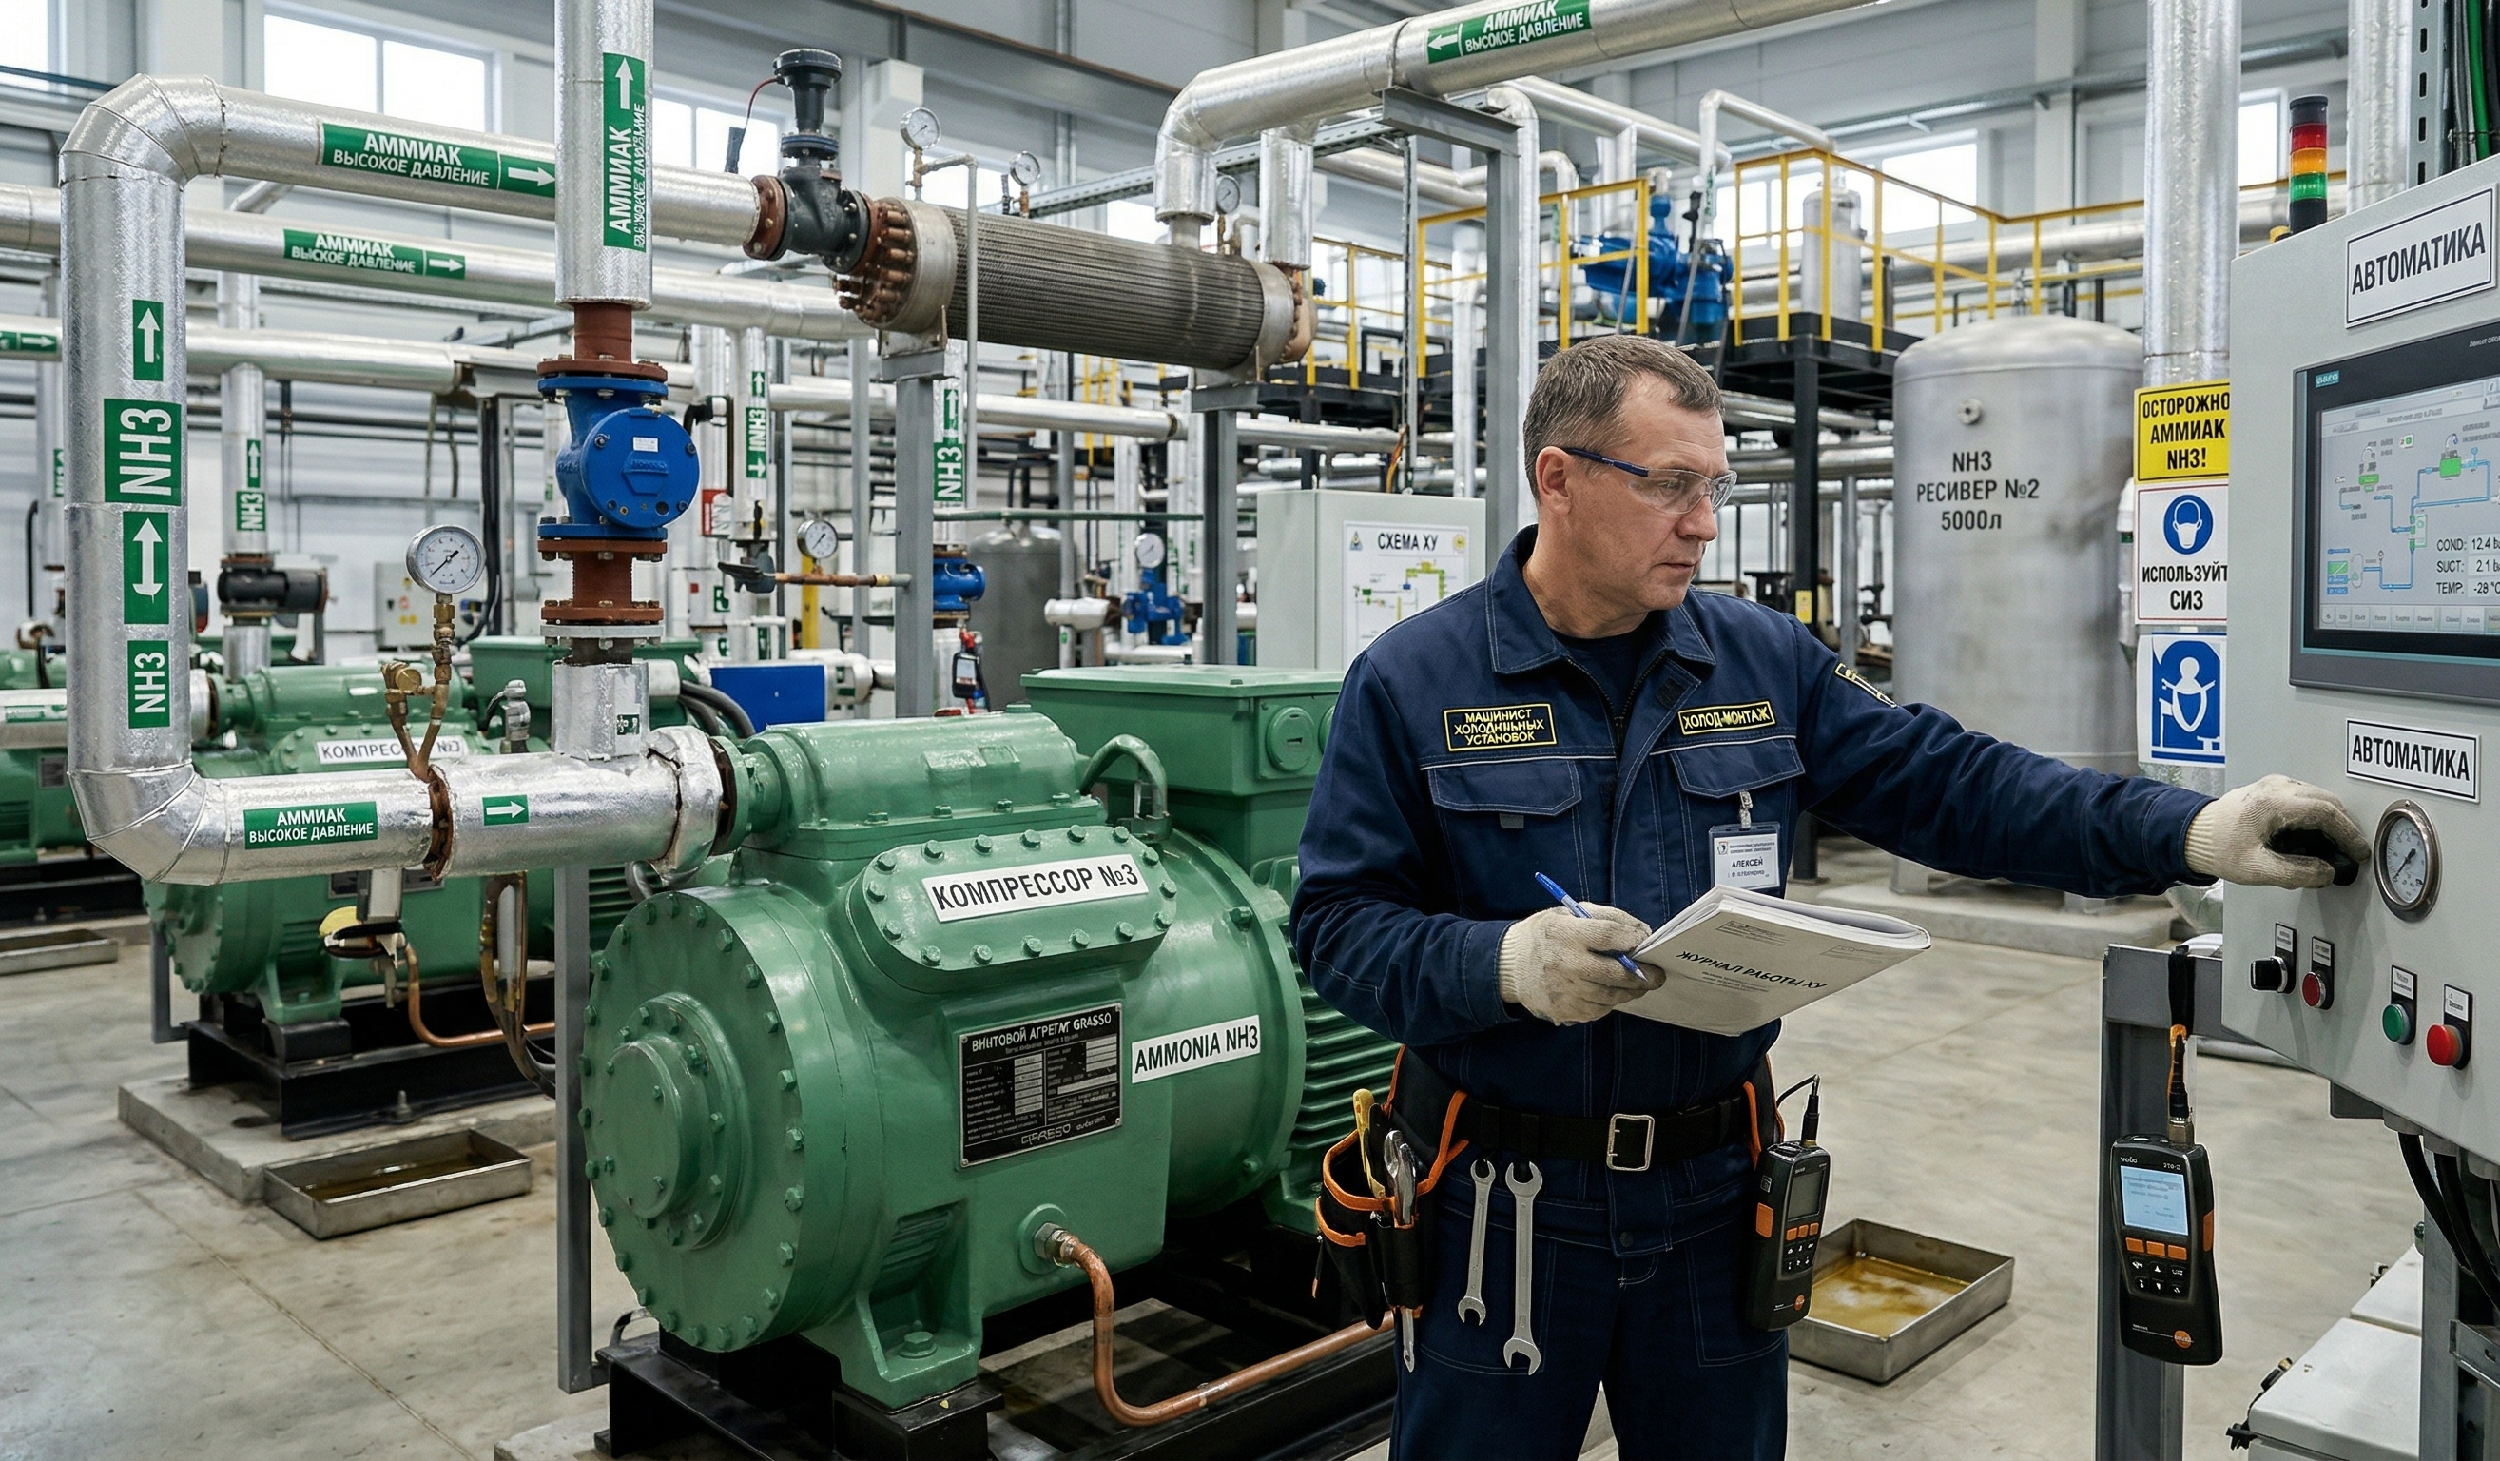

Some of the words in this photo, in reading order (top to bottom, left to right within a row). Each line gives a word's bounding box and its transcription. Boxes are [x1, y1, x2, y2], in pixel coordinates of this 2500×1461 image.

[1483, 0, 1559, 33] АММИАК
[1518, 12, 1584, 45] ДАВЛЕНИЕ
[363, 132, 463, 167] АММИАК
[333, 149, 408, 173] ВЫСОКОЕ
[410, 161, 490, 186] ДАВЛЕНИЕ
[609, 125, 632, 234] АММИАК
[315, 233, 396, 258] АММИАК
[2352, 222, 2486, 295] АВТОМАТИКА
[347, 253, 417, 274] ДАВЛЕНИЕ
[2142, 391, 2230, 419] ОСТОРОЖНО
[2150, 418, 2226, 445] АММИАК
[120, 408, 172, 496] NH3
[1952, 450, 1993, 473] NH3
[2167, 447, 2207, 470] NH3!
[936, 446, 963, 499] NH3
[1917, 479, 1998, 502] РЕСИВЕР
[2005, 478, 2040, 499] №2
[241, 493, 263, 530] NH3
[1941, 510, 2003, 531] 5000л
[1377, 533, 1420, 551] СХЕМА
[2436, 560, 2465, 573] SUCT:
[2169, 590, 2204, 611] СИЗ
[134, 651, 166, 713] NH3
[1465, 709, 1532, 723] МАШИНИСТ
[2352, 734, 2471, 782] АВТОМАТИКА
[277, 807, 347, 827] АММИАК
[249, 827, 308, 844] ВЫСОКОЕ
[310, 822, 374, 842] ДАВЛЕНИЕ
[932, 867, 1093, 910] КОМПРЕССОР
[1097, 863, 1139, 887] №3
[1073, 1012, 1112, 1030] GRASSO
[1134, 1039, 1221, 1075] AMMONIA
[1226, 1024, 1258, 1051] NH3
